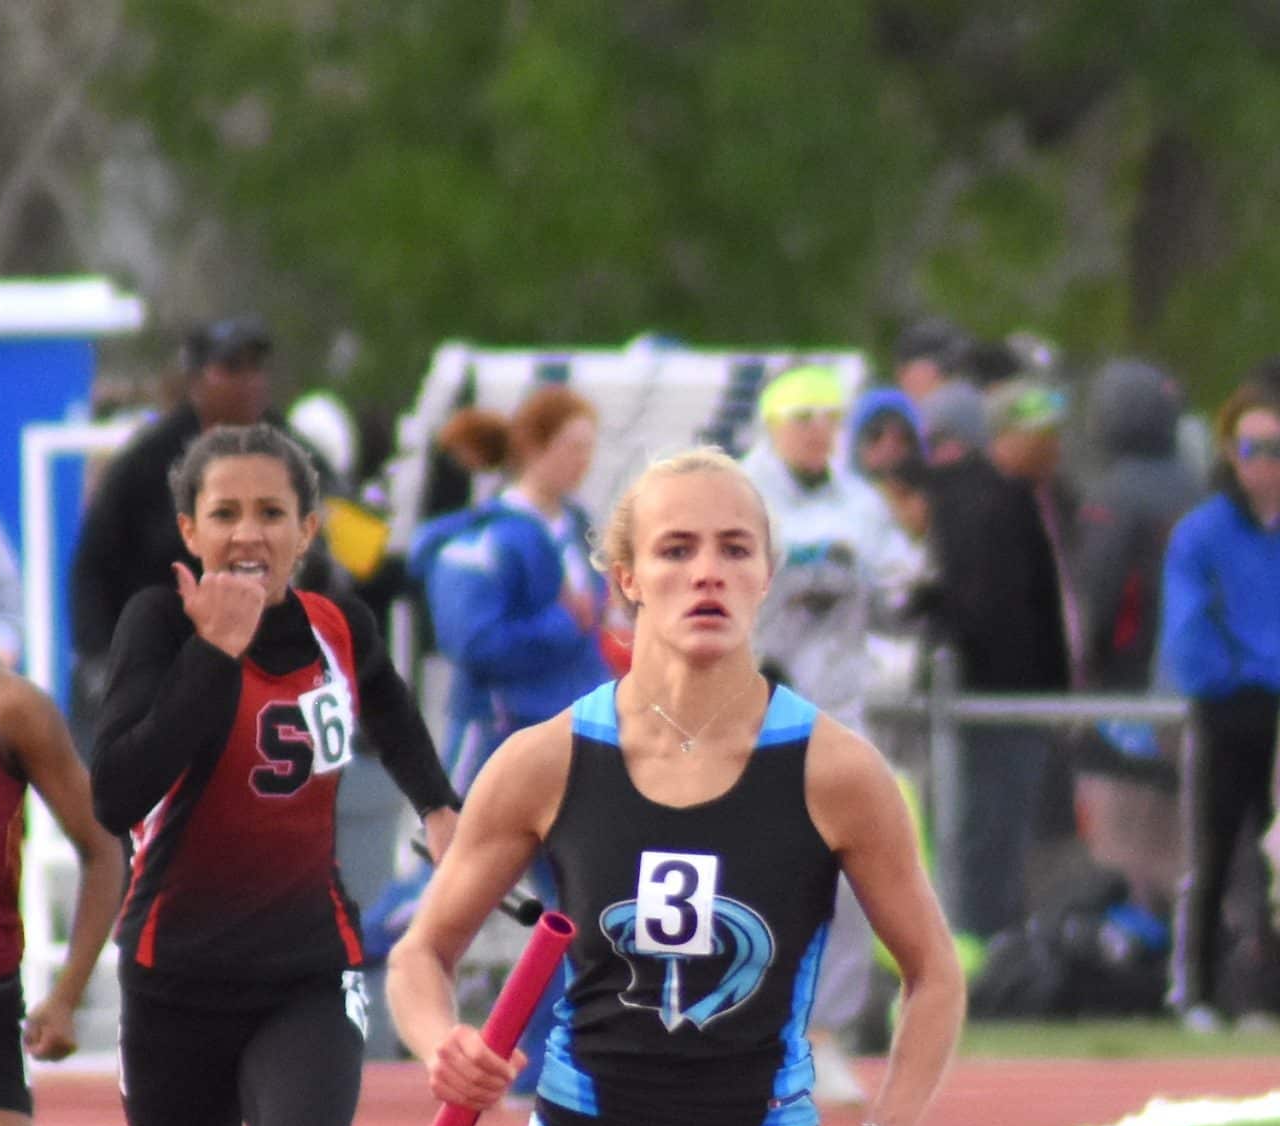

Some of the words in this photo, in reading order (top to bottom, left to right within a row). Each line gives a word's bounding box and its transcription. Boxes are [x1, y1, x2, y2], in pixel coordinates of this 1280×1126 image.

[248, 699, 315, 798] S
[313, 692, 345, 764] 6
[645, 860, 700, 946] 3
